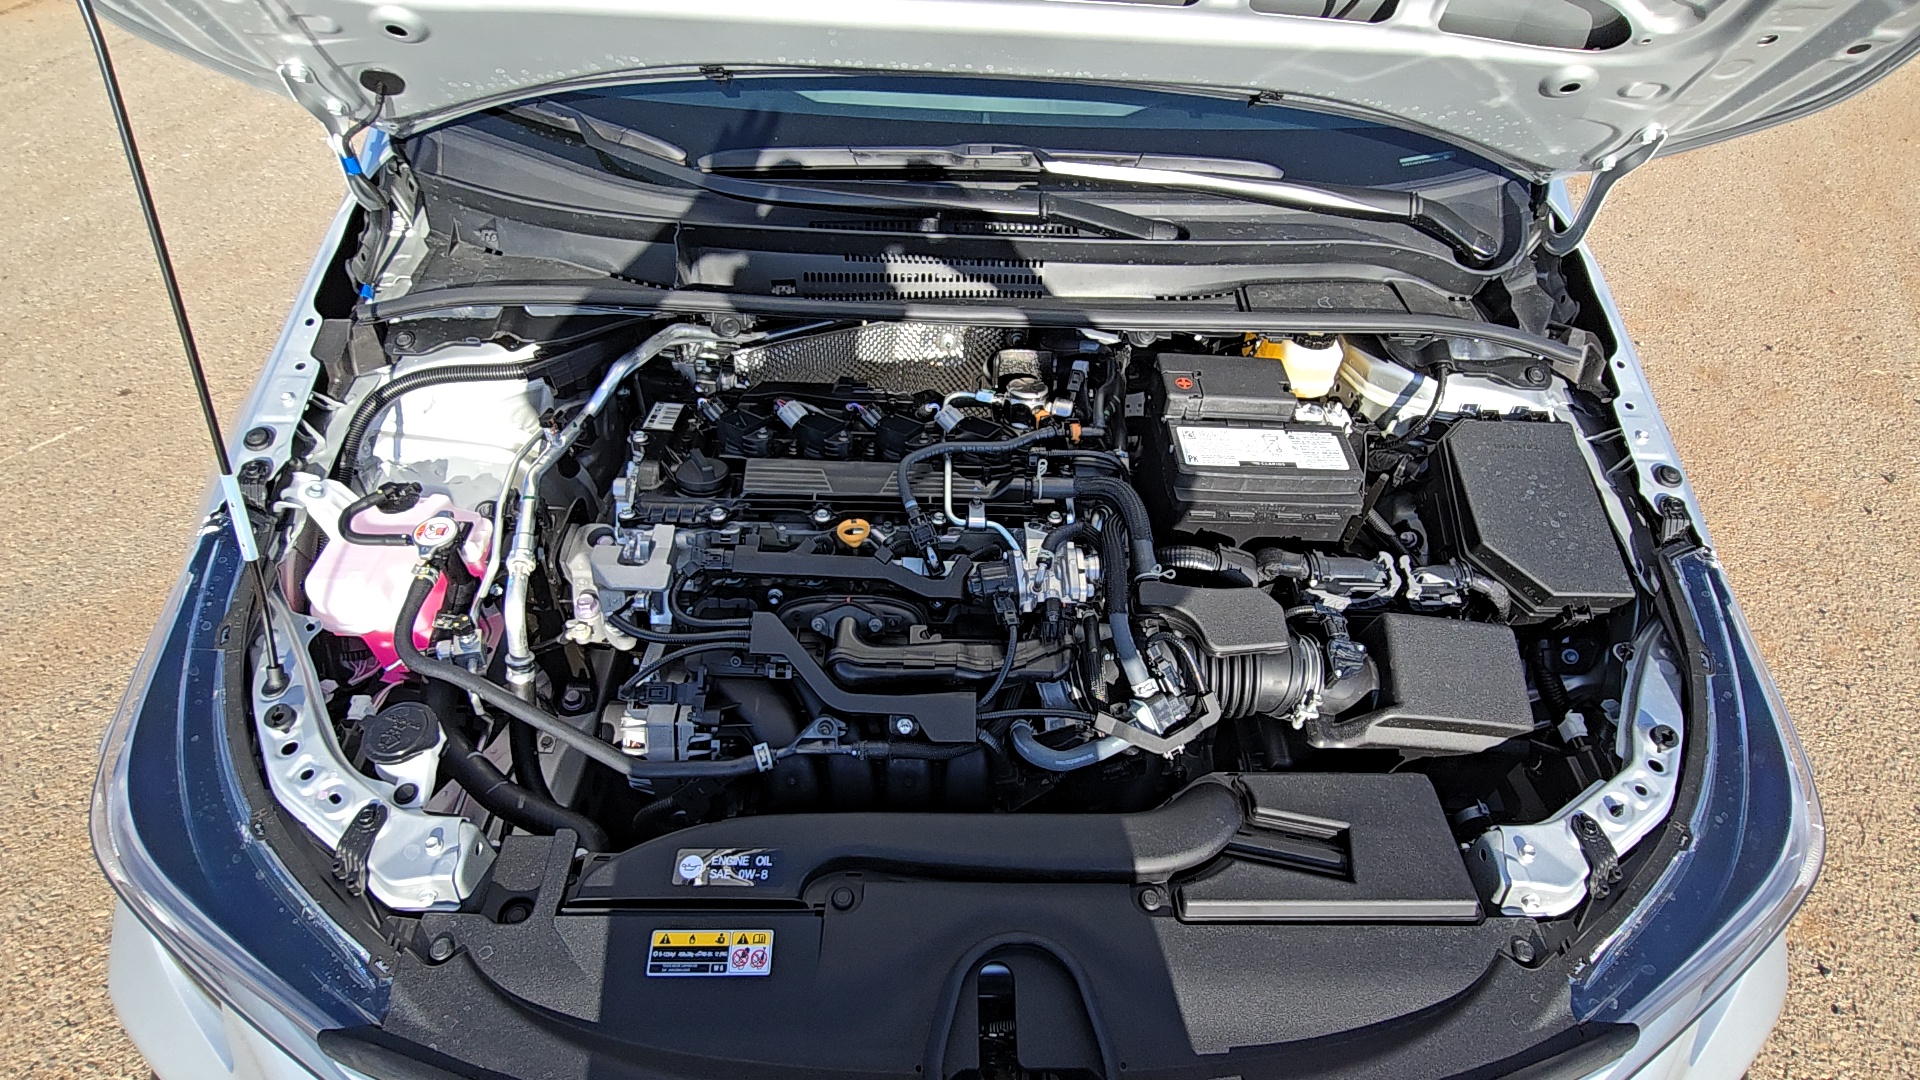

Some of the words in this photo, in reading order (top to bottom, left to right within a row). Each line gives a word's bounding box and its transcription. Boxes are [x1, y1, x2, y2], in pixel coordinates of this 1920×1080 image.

[711, 855, 750, 867] ENGINE
[755, 855, 773, 867] OIL
[709, 868, 731, 879] SAE
[738, 869, 769, 880] 0W-8
